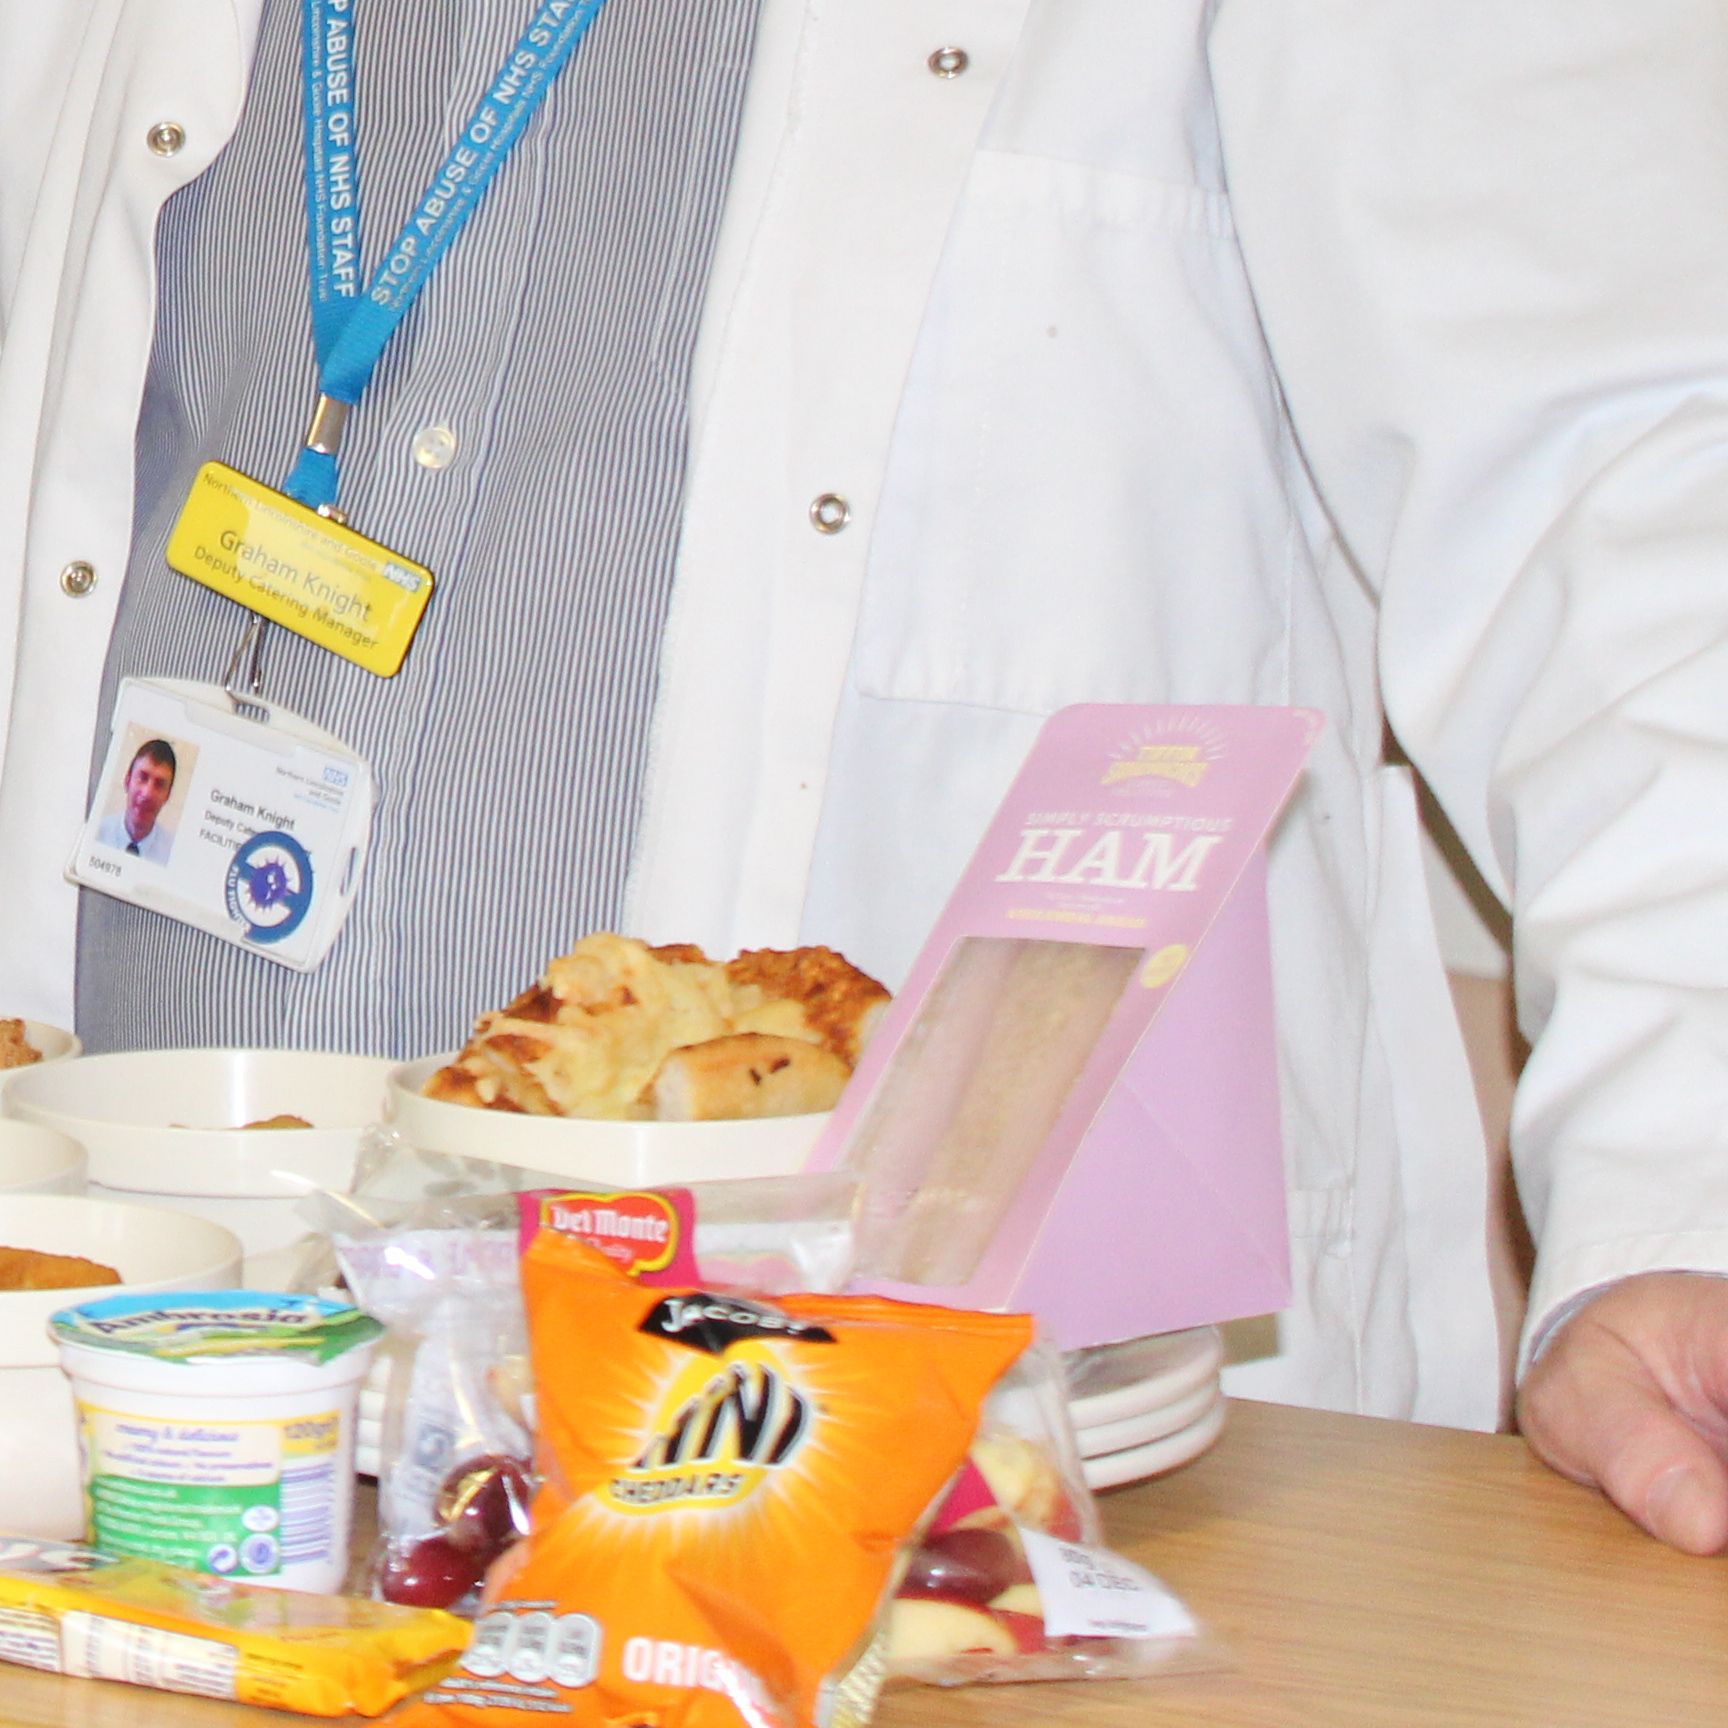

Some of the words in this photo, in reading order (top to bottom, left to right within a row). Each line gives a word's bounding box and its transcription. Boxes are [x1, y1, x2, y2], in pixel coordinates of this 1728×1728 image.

[326, 17, 348, 106] ABUSE
[328, 111, 349, 148] OF
[329, 154, 352, 210] NHS
[370, 236, 418, 306] STOP
[415, 145, 478, 237] ABUSE
[469, 105, 499, 145] OF
[493, 49, 537, 105] NHS
[331, 216, 357, 299] STAFF
[193, 545, 245, 585] Deputy
[248, 574, 311, 620] Catering
[312, 603, 380, 651] Manager
[219, 529, 299, 585] Graham
[303, 571, 373, 623] Knight
[384, 563, 421, 591] NHS
[210, 789, 255, 816] Graham
[257, 805, 296, 831] Knight
[993, 826, 1225, 892] HAM
[550, 1204, 591, 1234] Del
[593, 1208, 669, 1243] Monte
